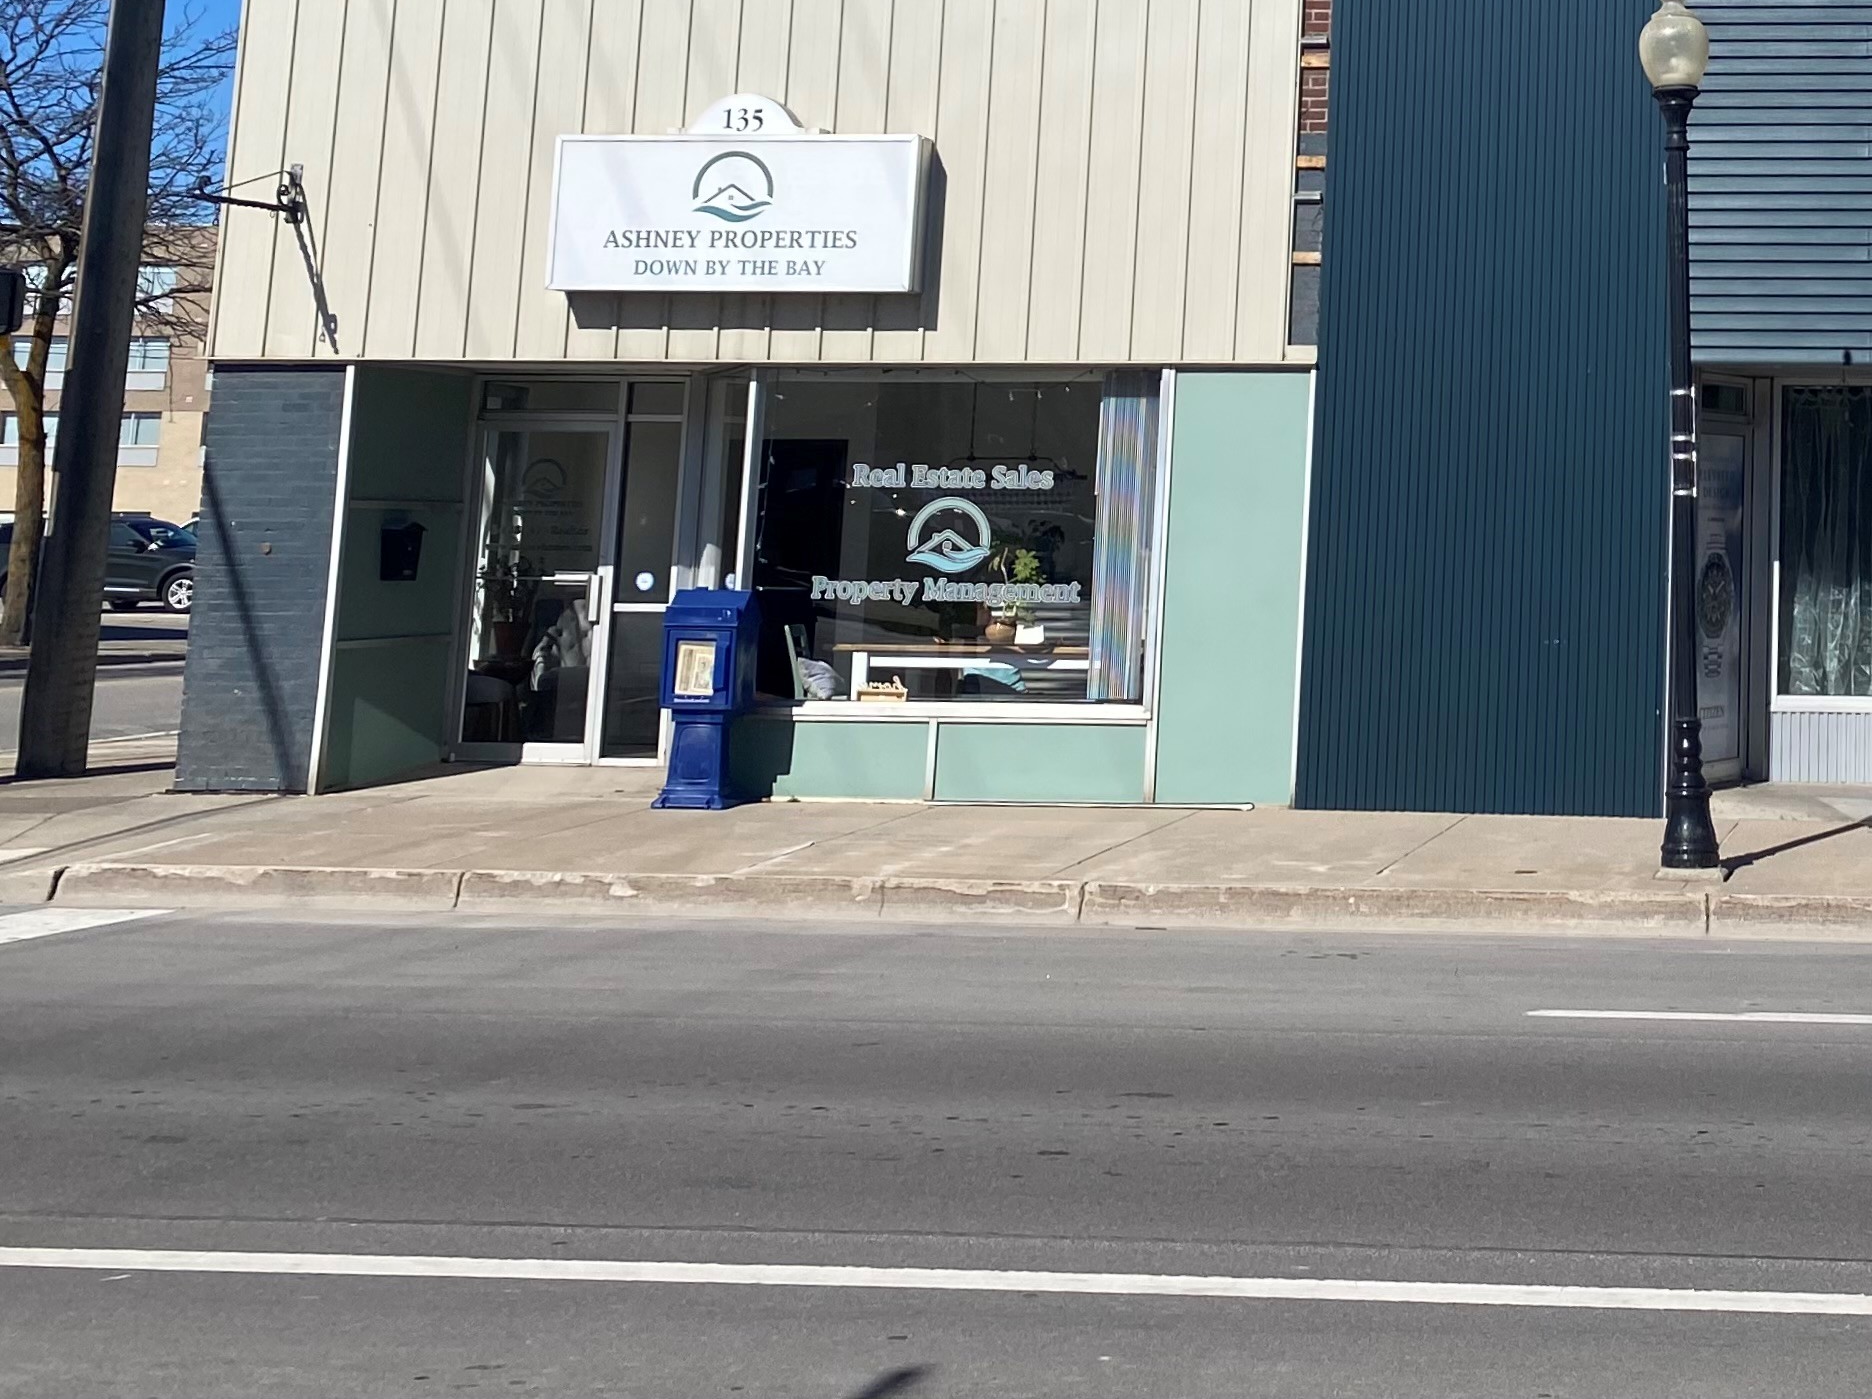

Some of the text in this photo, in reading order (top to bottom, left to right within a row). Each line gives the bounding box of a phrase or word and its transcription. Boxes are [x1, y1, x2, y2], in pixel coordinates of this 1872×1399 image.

[723, 108, 764, 132] 135
[603, 230, 858, 250] ASHNEY PROPERTIES
[633, 259, 826, 276] DOWN BY THE BAY
[852, 462, 1055, 490] Real Estate Sales
[810, 575, 1082, 606] Property Management
